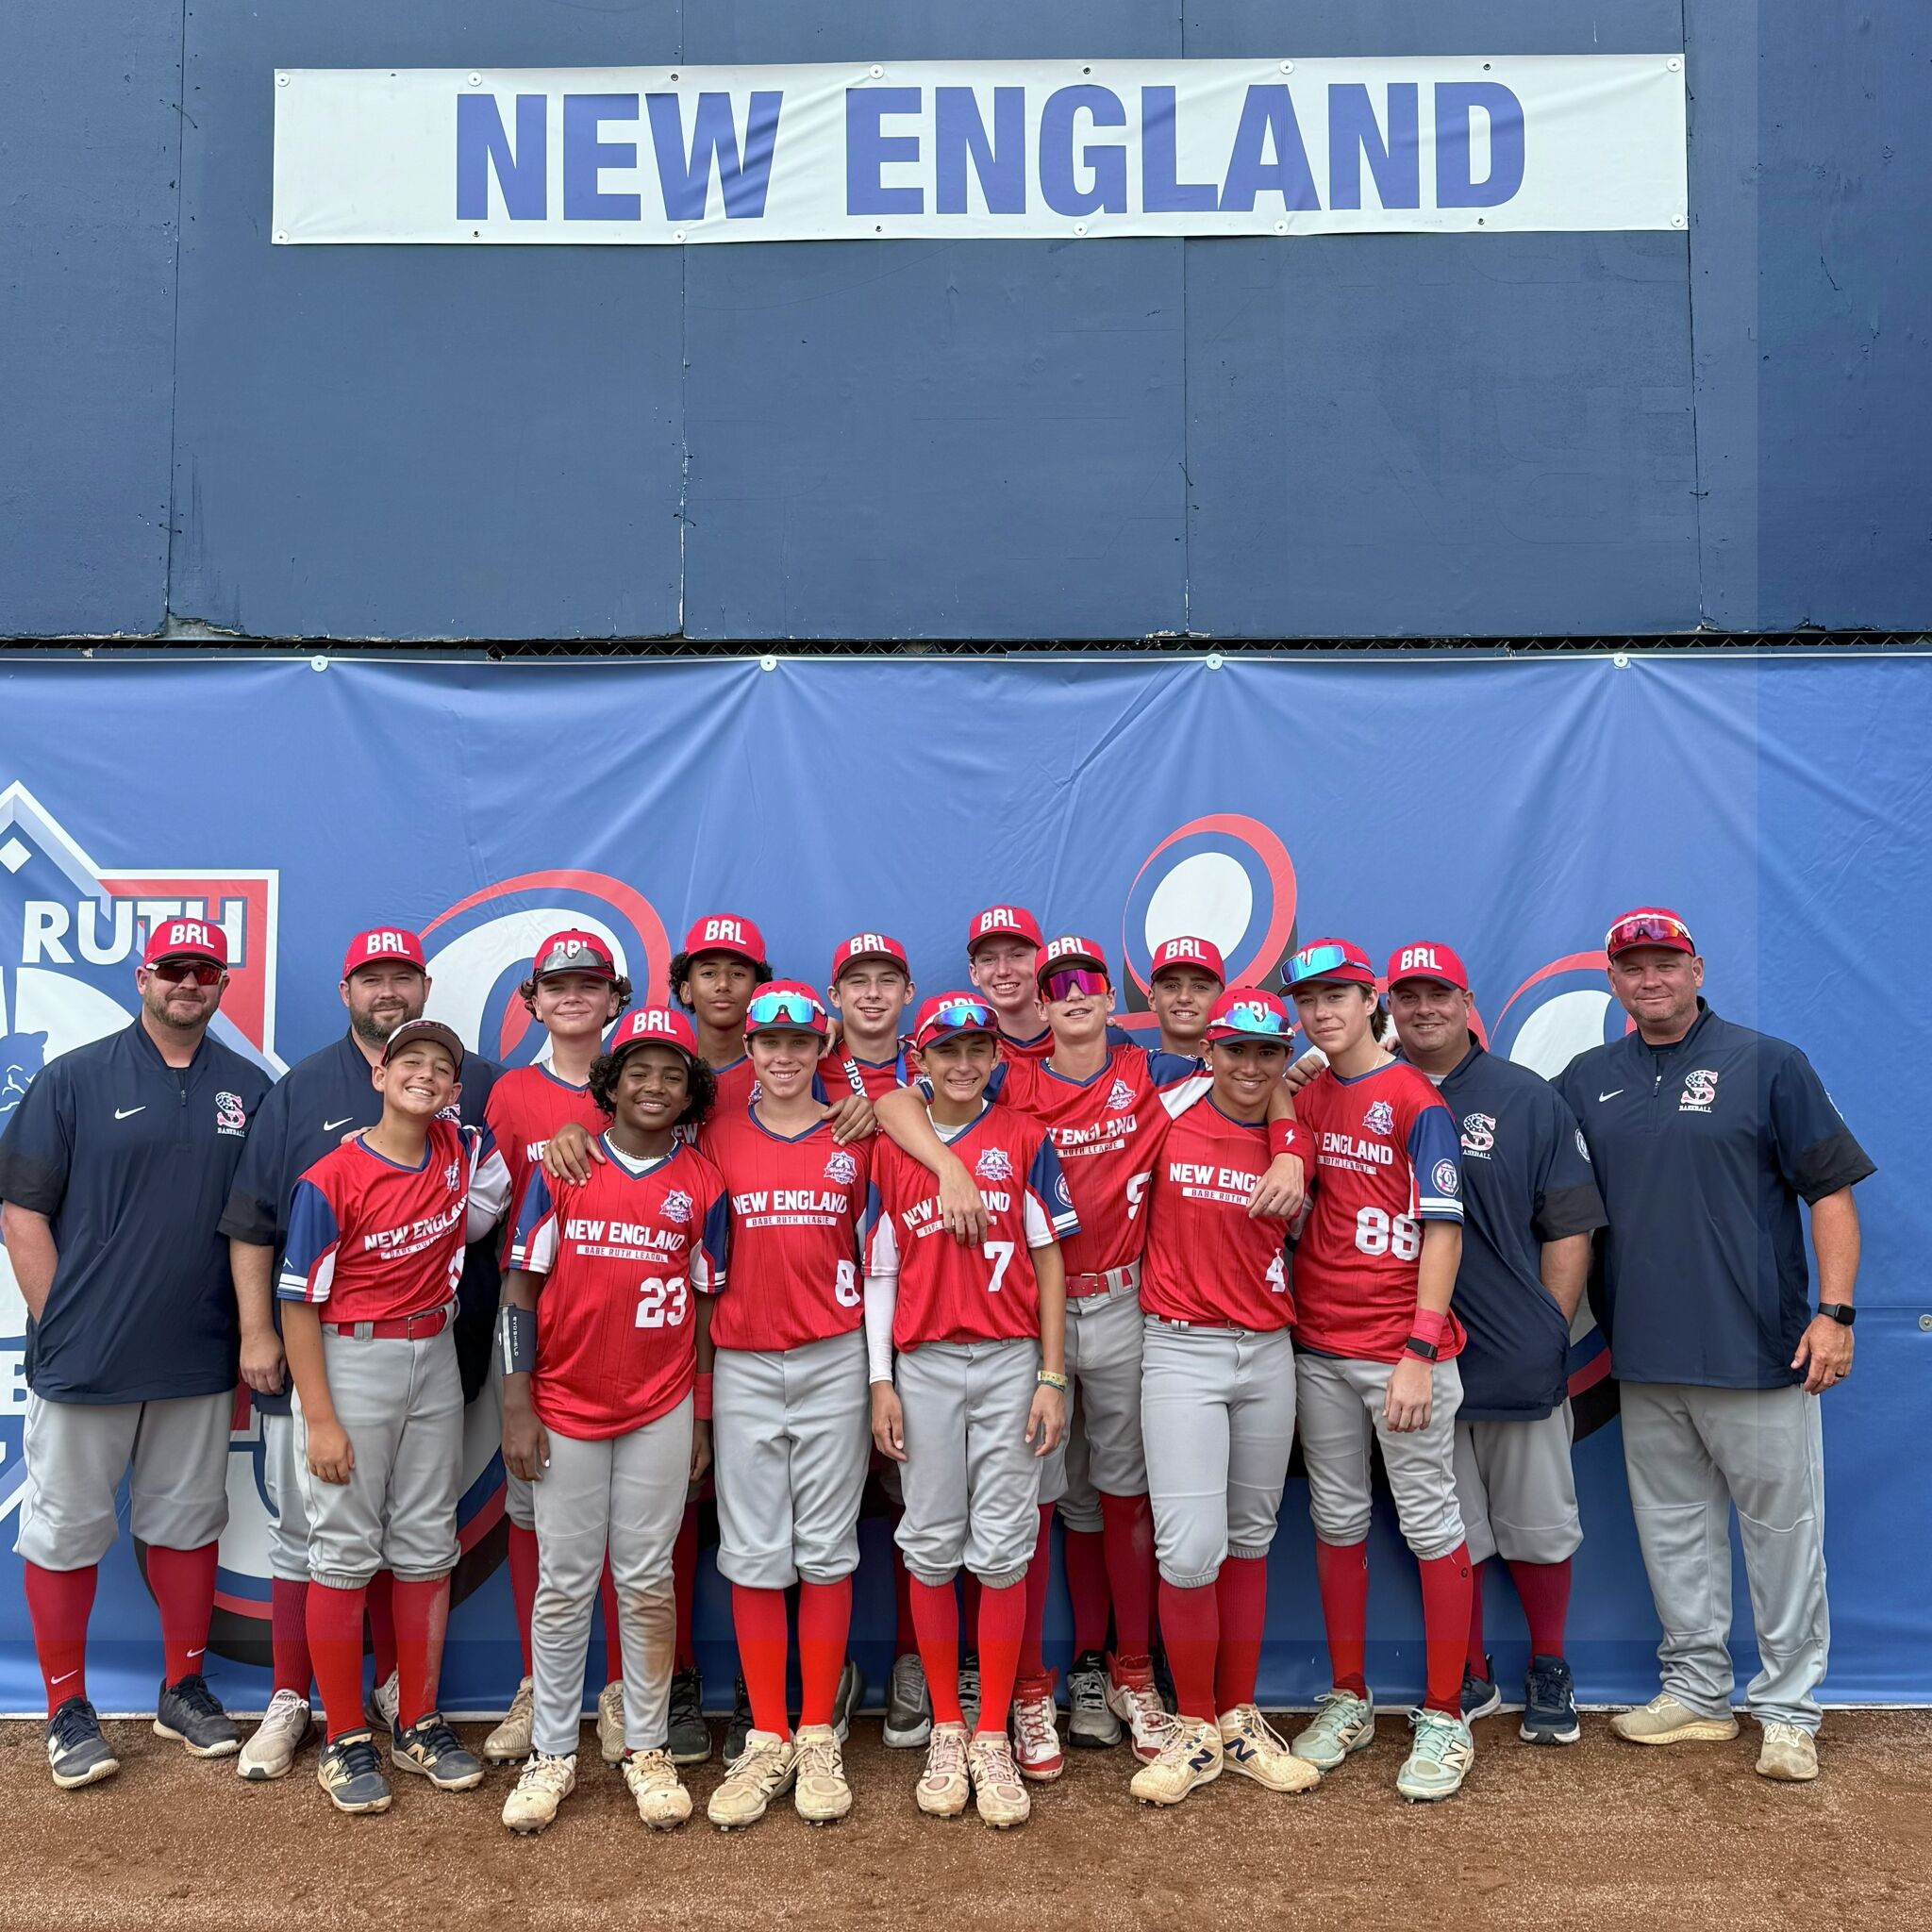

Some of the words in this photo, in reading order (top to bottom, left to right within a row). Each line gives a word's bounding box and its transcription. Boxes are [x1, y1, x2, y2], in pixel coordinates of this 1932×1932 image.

[457, 91, 784, 222] NEW
[845, 81, 1526, 217] ENGLAND
[704, 920, 747, 944] BRL
[980, 908, 1022, 932] BRL
[170, 924, 215, 949] BRL
[367, 932, 410, 955] BRL
[850, 934, 891, 955] BRL
[1047, 937, 1091, 959] BRL
[1164, 939, 1208, 960] BRL
[1400, 947, 1443, 971] BRL
[632, 1010, 677, 1035] BRL
[843, 1058, 868, 1097] AGUE
[1061, 1114, 1138, 1145] ENGLAND
[526, 1140, 550, 1163] NE
[1322, 1132, 1393, 1165] ENGLAND
[1463, 1149, 1491, 1160] ASEBALL
[1170, 1162, 1215, 1185] NEW
[732, 1191, 769, 1215] NEW
[773, 1190, 848, 1214] ENGLAND
[1191, 1189, 1215, 1199] BABE
[1219, 1193, 1242, 1204] RUTH
[752, 1217, 773, 1226] BABE
[776, 1216, 798, 1224] RUTH
[1356, 1206, 1422, 1261] 88
[364, 1225, 408, 1252] NEW
[564, 1219, 607, 1241] NEW
[608, 1222, 686, 1251] ENGLAND
[585, 1246, 605, 1256] BABE
[608, 1248, 631, 1258] RUTH
[984, 1241, 1015, 1292] 7
[1265, 1247, 1287, 1293] 4
[834, 1259, 860, 1307] 8
[634, 1277, 687, 1328] 23
